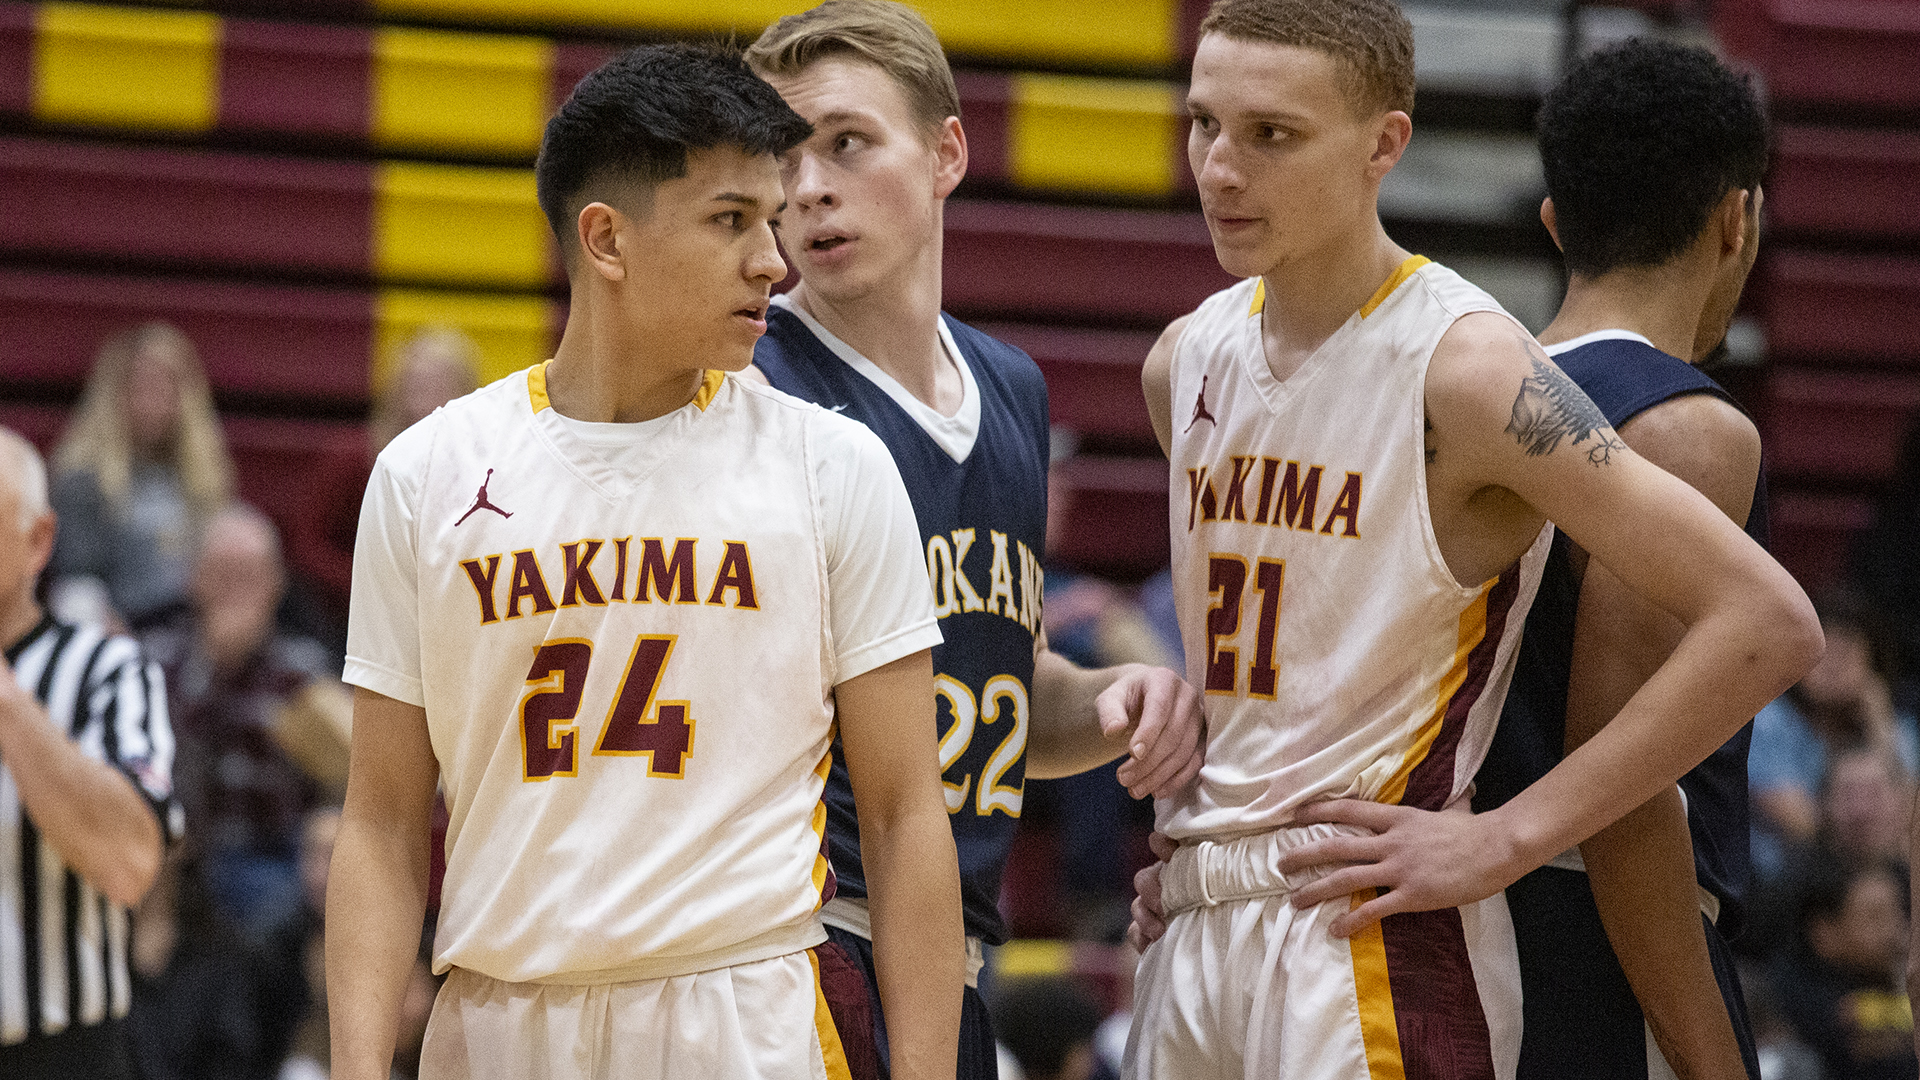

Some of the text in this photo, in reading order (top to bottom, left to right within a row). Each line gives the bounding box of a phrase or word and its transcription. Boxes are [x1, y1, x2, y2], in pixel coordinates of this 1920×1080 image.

[1187, 455, 1363, 540] YAKIMA
[459, 535, 761, 626] YAKIMA
[1205, 552, 1286, 701] 21
[518, 633, 696, 783] 24
[934, 673, 1029, 818] 22
